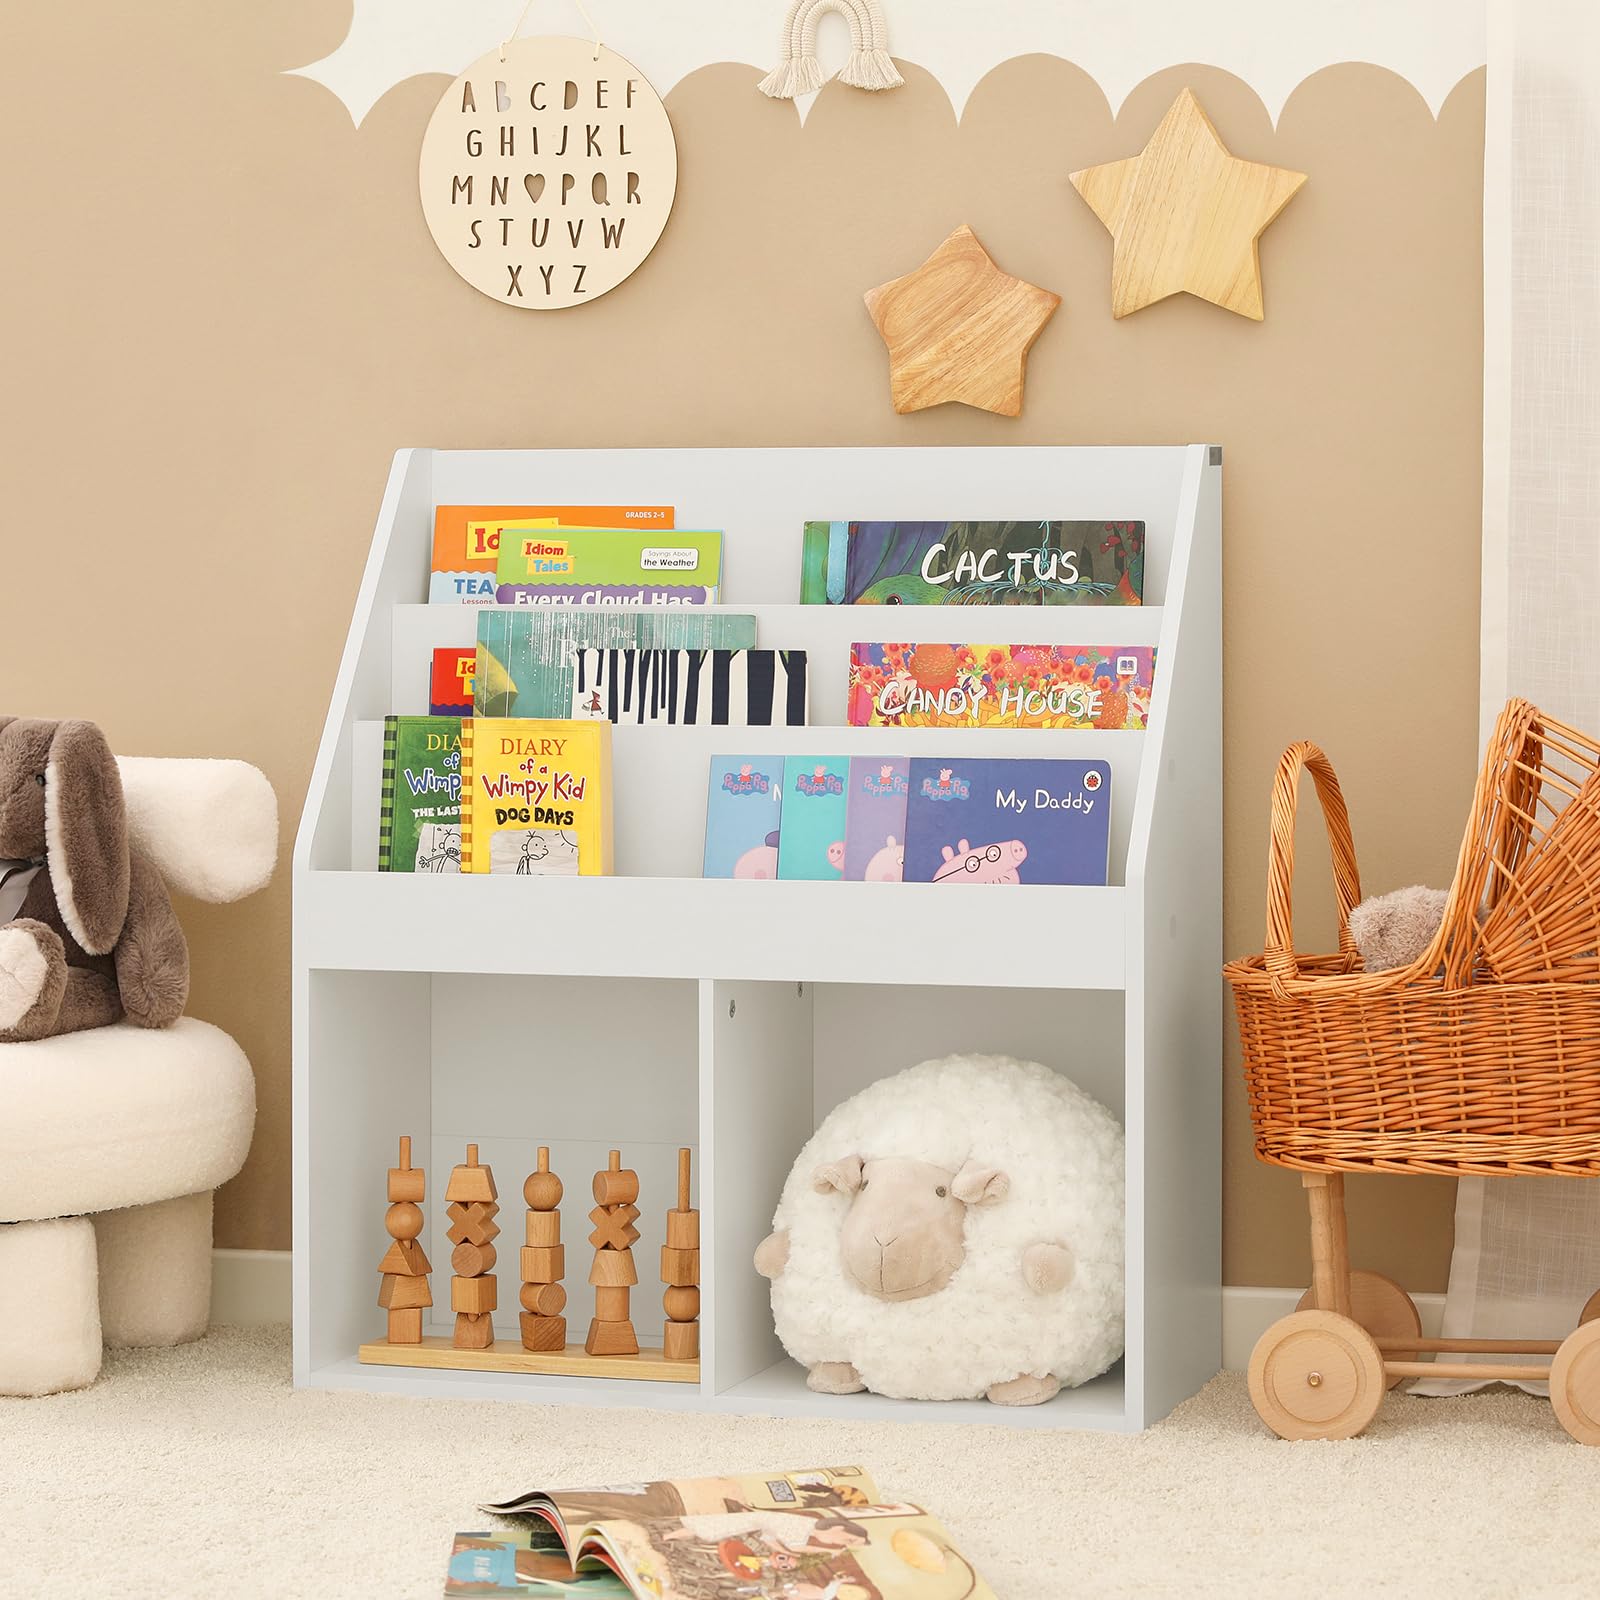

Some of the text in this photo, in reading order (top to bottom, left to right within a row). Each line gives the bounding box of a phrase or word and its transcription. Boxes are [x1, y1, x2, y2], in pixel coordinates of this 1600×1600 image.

[625, 511, 652, 519] GRADES
[525, 542, 564, 556] Idiom
[648, 550, 672, 558] Sayings
[533, 559, 569, 573] Tales
[644, 558, 695, 567] the Weather
[920, 543, 1080, 587] CACTUS
[581, 590, 645, 605] Cloud
[651, 591, 693, 605] Has
[608, 626, 631, 639] The
[879, 682, 988, 719] CANDY
[1000, 685, 1104, 719] HOUSE
[500, 738, 568, 755] DIARY
[444, 752, 460, 770] of
[519, 758, 548, 774] of a
[403, 768, 463, 801] Wimp
[481, 772, 586, 806] Wimpy Kid
[996, 789, 1094, 814] My Daddy
[411, 806, 435, 819] THE
[495, 807, 574, 826] DOG DAYS
